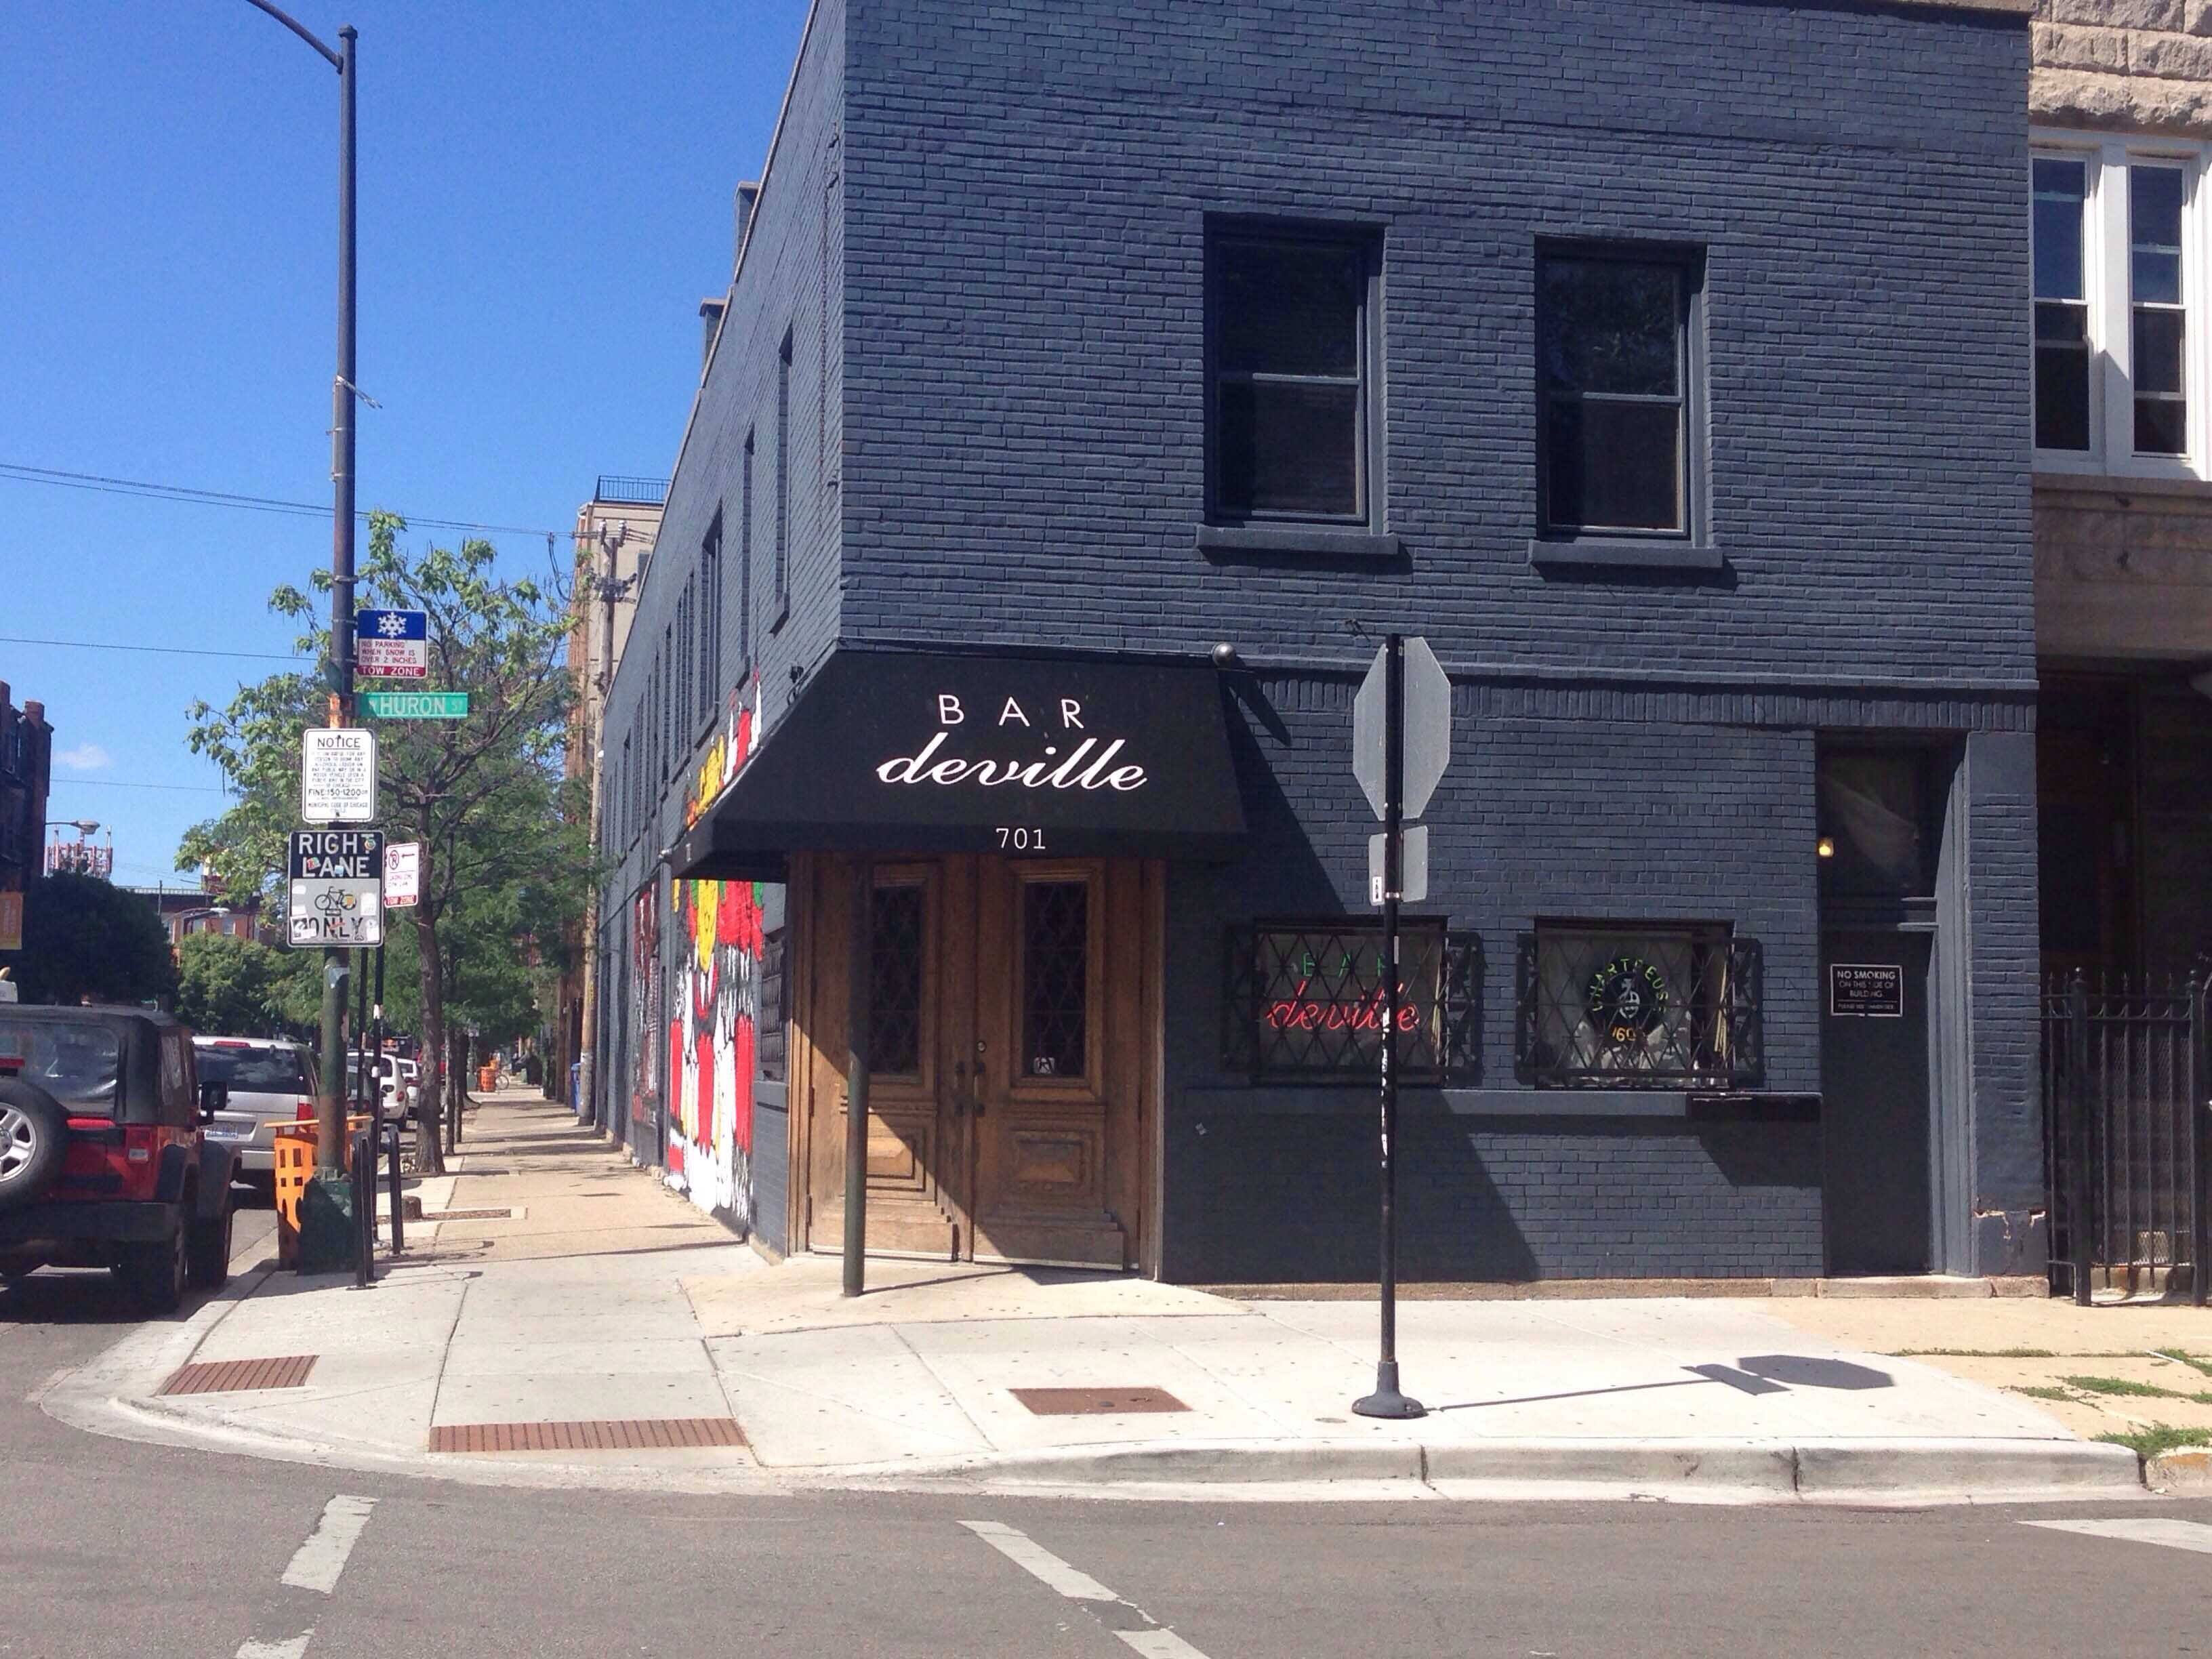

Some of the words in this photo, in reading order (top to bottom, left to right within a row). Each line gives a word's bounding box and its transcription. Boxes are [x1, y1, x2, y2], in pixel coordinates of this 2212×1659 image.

[375, 640, 405, 649] PARKING
[362, 665, 385, 675] TOW
[390, 667, 422, 676] ZONE
[380, 696, 446, 716] HURON
[451, 699, 464, 712] ST
[938, 694, 1085, 729] BAR
[317, 737, 361, 748] NOTICE
[875, 731, 1149, 792] deville
[299, 834, 375, 855] RIGHT
[996, 827, 1046, 850] 701
[302, 856, 370, 878] LANE
[1837, 970, 1852, 979] NO
[1854, 970, 1896, 980] SMOKING
